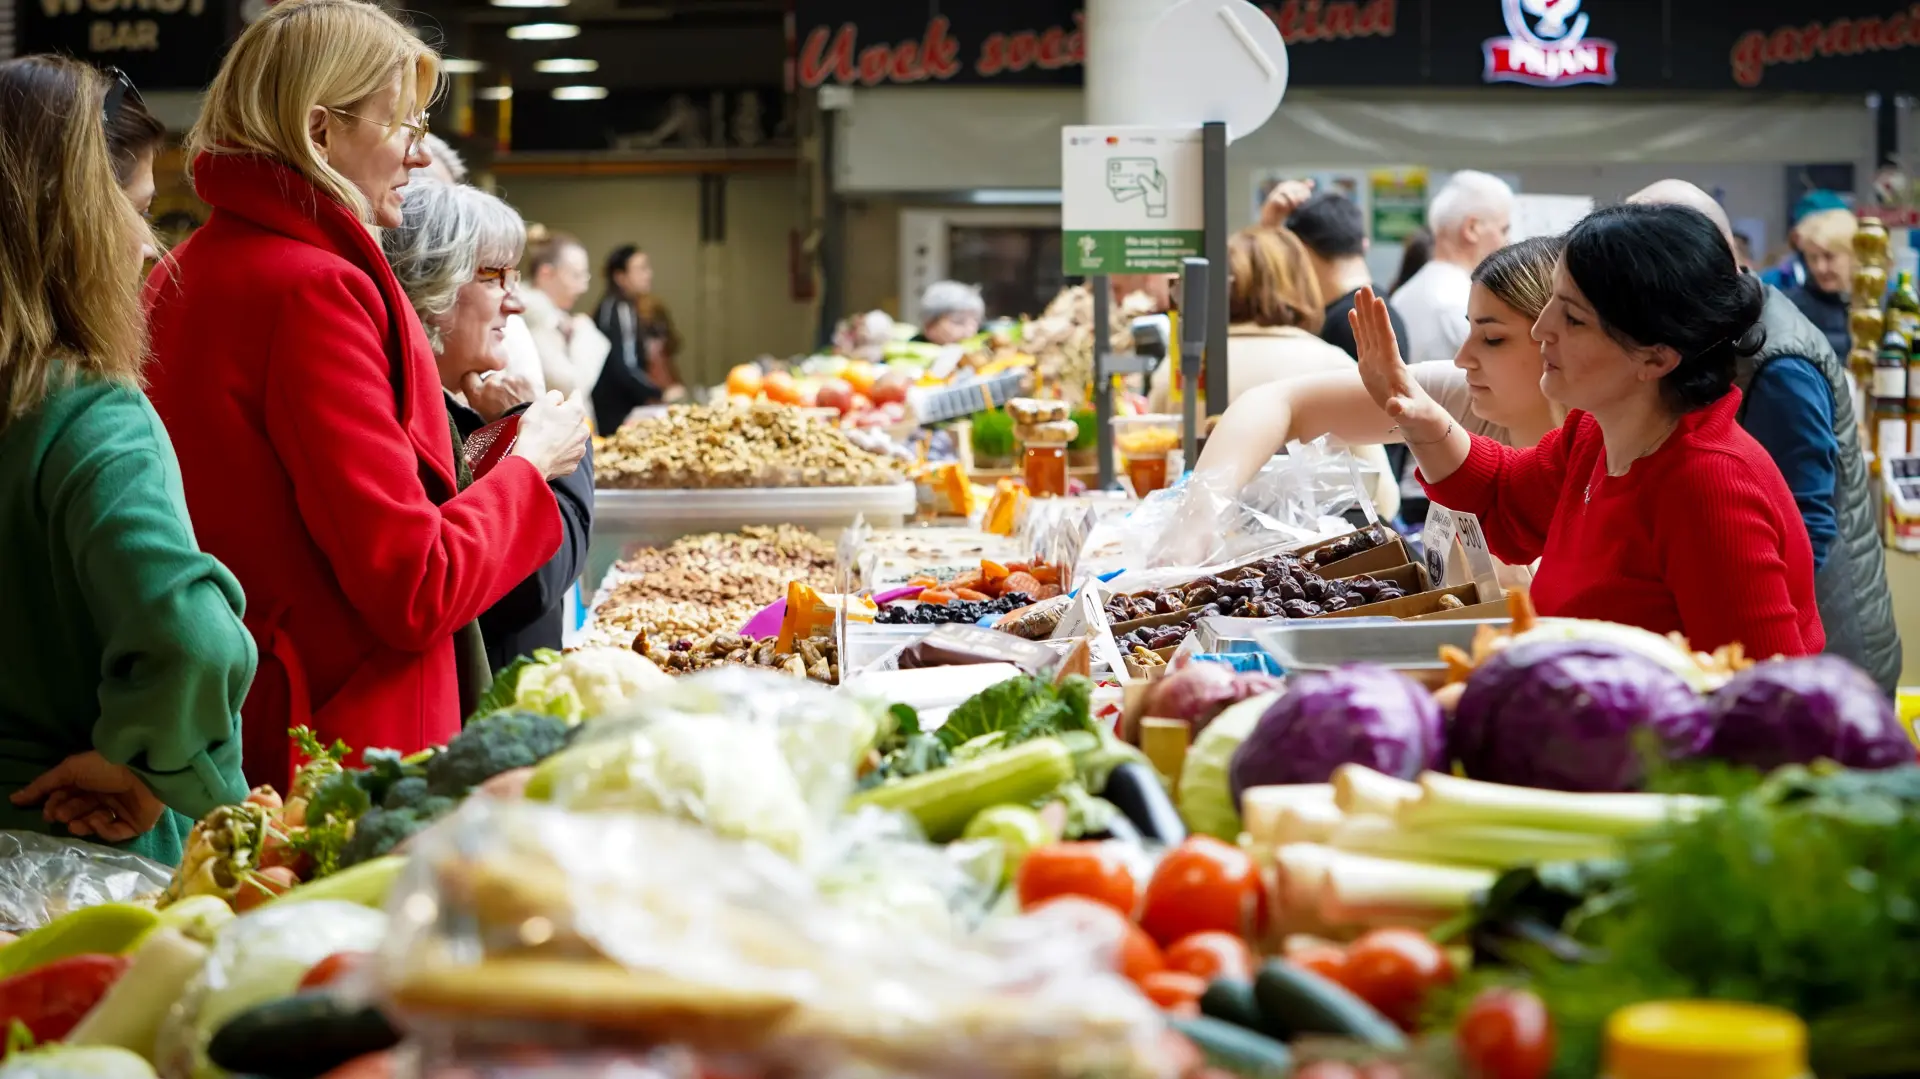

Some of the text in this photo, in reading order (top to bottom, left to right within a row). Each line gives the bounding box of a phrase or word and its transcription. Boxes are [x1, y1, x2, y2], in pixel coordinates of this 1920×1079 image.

[89, 20, 159, 52] BAR
[799, 15, 961, 88] Uvek
[1459, 517, 1481, 549] 900
